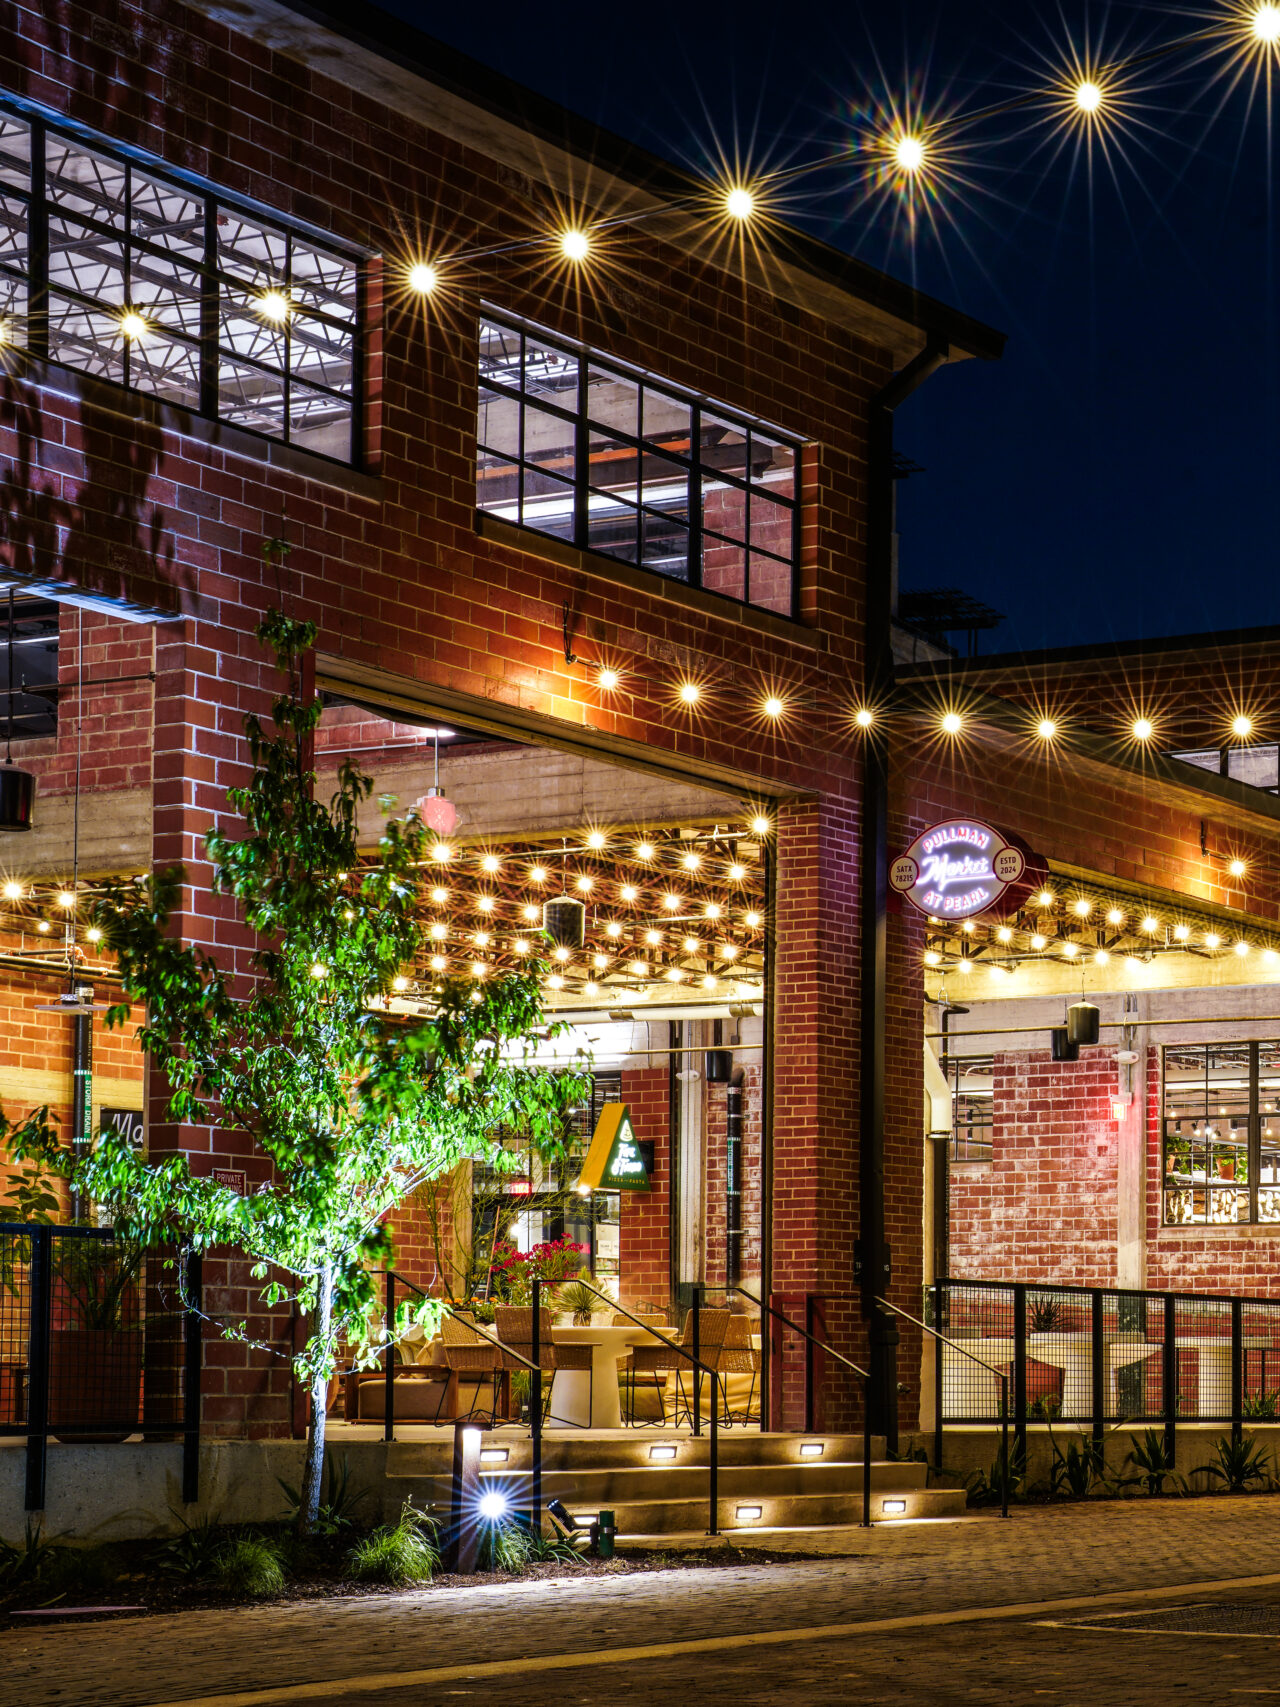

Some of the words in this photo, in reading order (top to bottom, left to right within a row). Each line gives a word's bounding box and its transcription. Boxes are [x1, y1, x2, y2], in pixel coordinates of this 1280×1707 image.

[922, 827, 990, 854] PULLMAN
[1000, 856, 1017, 865] ESTD
[920, 851, 992, 891] Market
[1000, 865, 1017, 875] 2024
[895, 875, 914, 883] 78215
[923, 890, 943, 910] AT
[943, 887, 990, 911] PEARL
[217, 1173, 242, 1184] PRIVATE
